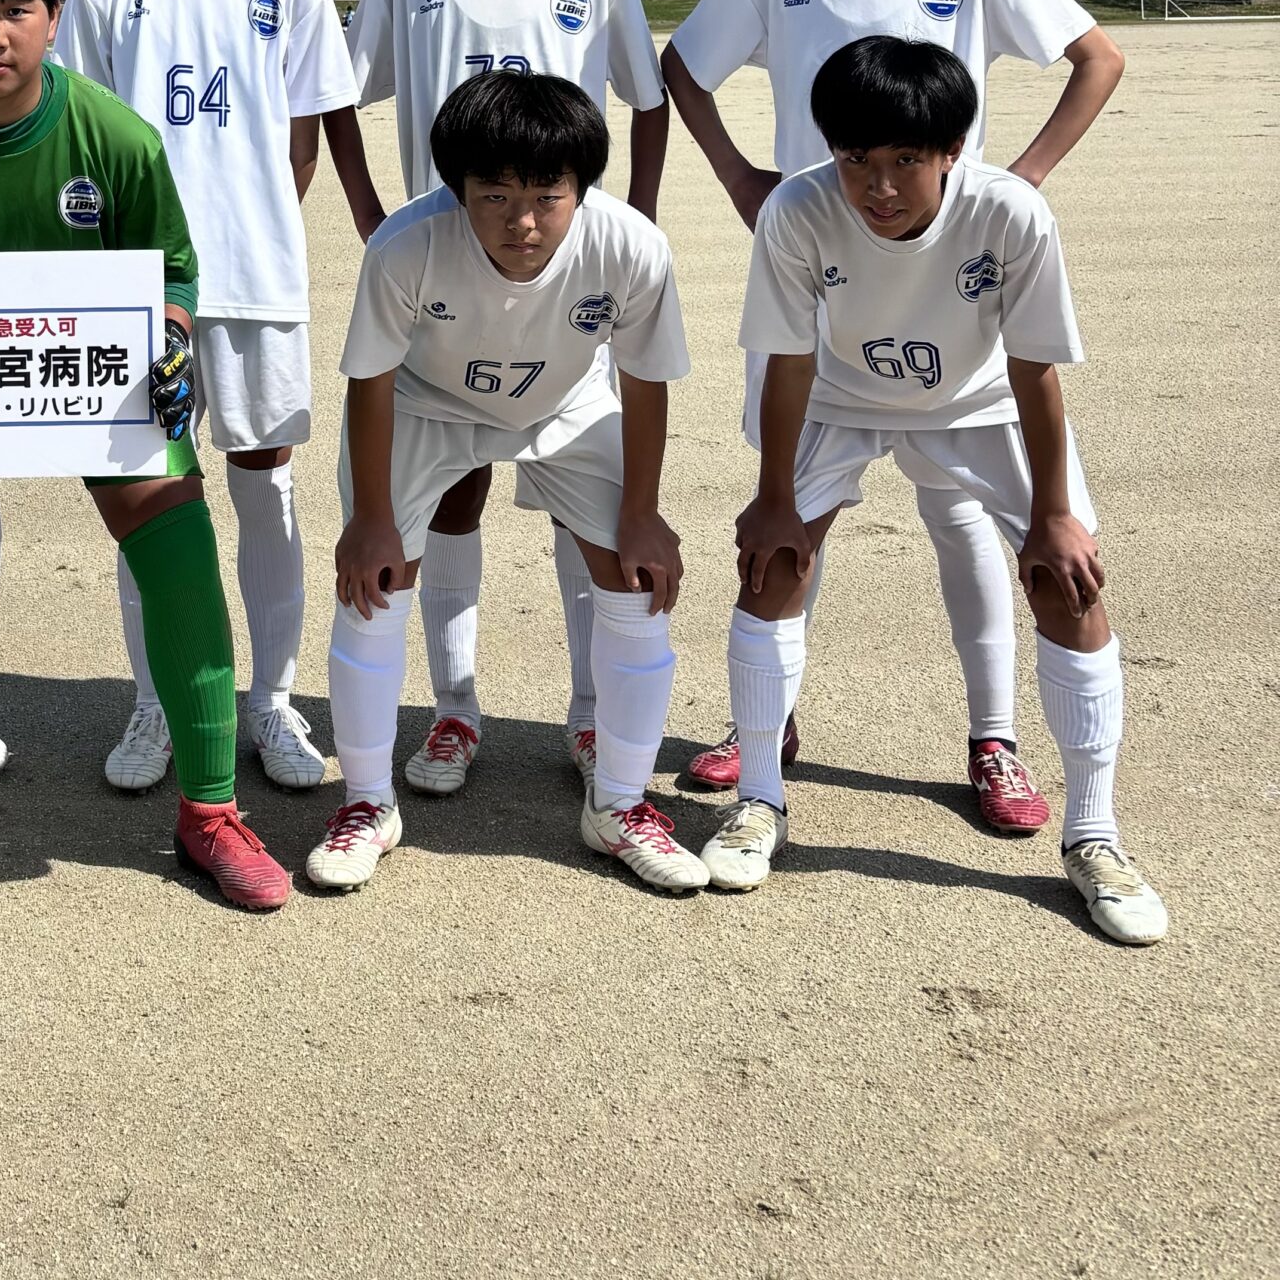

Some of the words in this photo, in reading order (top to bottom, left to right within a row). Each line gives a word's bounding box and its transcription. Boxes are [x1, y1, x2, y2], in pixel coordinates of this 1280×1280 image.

[556, 2, 587, 18] LIBRE
[166, 64, 231, 128] 64
[65, 200, 99, 211] LIBR
[464, 360, 546, 399] 67
[862, 337, 942, 390] 69
